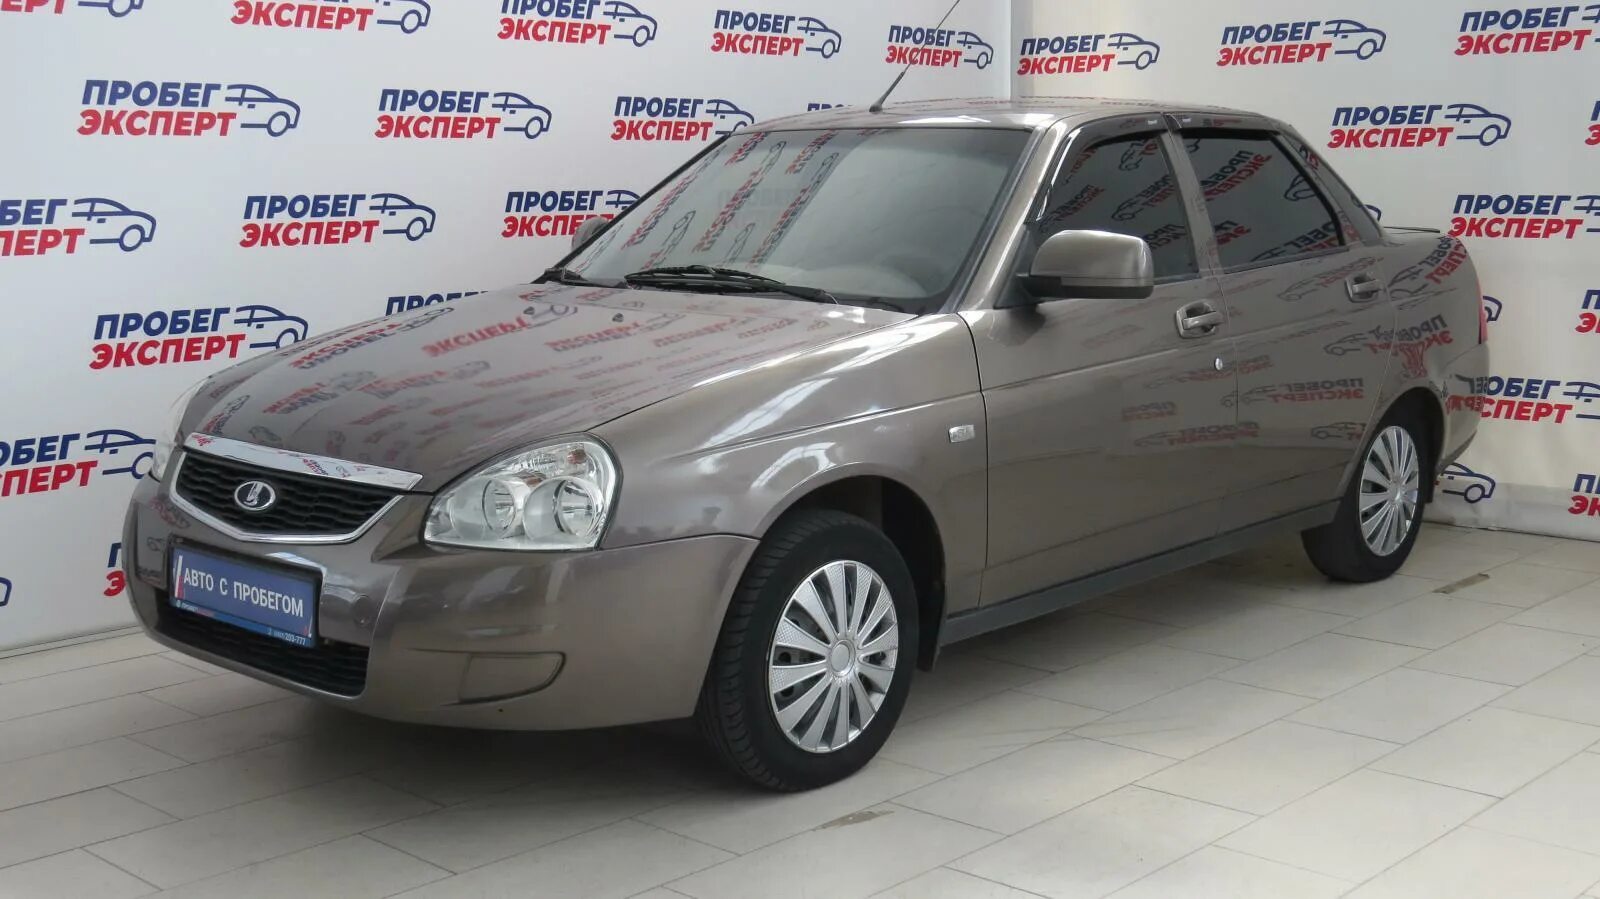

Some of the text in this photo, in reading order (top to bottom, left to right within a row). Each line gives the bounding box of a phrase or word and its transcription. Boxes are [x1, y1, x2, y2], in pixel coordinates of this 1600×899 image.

[232, 0, 374, 30] ЭКСПЕРТ
[502, 0, 600, 19] ПРОБЕГ
[715, 10, 795, 33] ПРОБЕГ
[1460, 6, 1579, 32] ПРОБЕГ
[499, 18, 611, 44] ЭКСПЕРТ
[889, 26, 955, 45] ПРОБЕГ
[1223, 21, 1320, 43] ПРОБЕГ
[1456, 29, 1592, 55] ЭКСПЕРТ
[711, 32, 804, 55] ЭКСПЕРТ
[886, 45, 961, 66] ЭКСПЕРТ
[1021, 35, 1104, 55] ПРОБЕГ
[1218, 42, 1332, 66] ЭКСПЕРТ
[1017, 53, 1116, 75] ЭКСПЕРТ
[82, 80, 221, 107] ПРОБЕГ
[379, 89, 489, 113] ПРОБЕГ
[615, 97, 703, 117] ПРОБЕГ
[1332, 105, 1440, 126] ПРОБЕГ
[79, 109, 236, 136] ЭКСПЕРТ
[376, 114, 501, 139] ЭКСПЕРТ
[611, 120, 713, 141] ЭКСПЕРТ
[1328, 127, 1453, 148] ЭКСПЕРТ
[244, 194, 366, 219] ПРОБЕГ
[505, 191, 603, 212] ПРОБЕГ
[1454, 195, 1571, 215] ПРОБЕГ
[240, 220, 379, 248] ЭКСПЕРТ
[501, 213, 614, 238] ЭКСПЕ
[1449, 217, 1583, 238] ЭКСПЕРТ
[94, 307, 230, 340] ПРОБЕГ
[91, 333, 246, 369] ЭКСПЕРТ
[0, 461, 97, 496] ПЕРТ
[183, 568, 214, 591] АВТО
[220, 578, 228, 595] С
[233, 581, 304, 617] ПРОБЕГОМ
